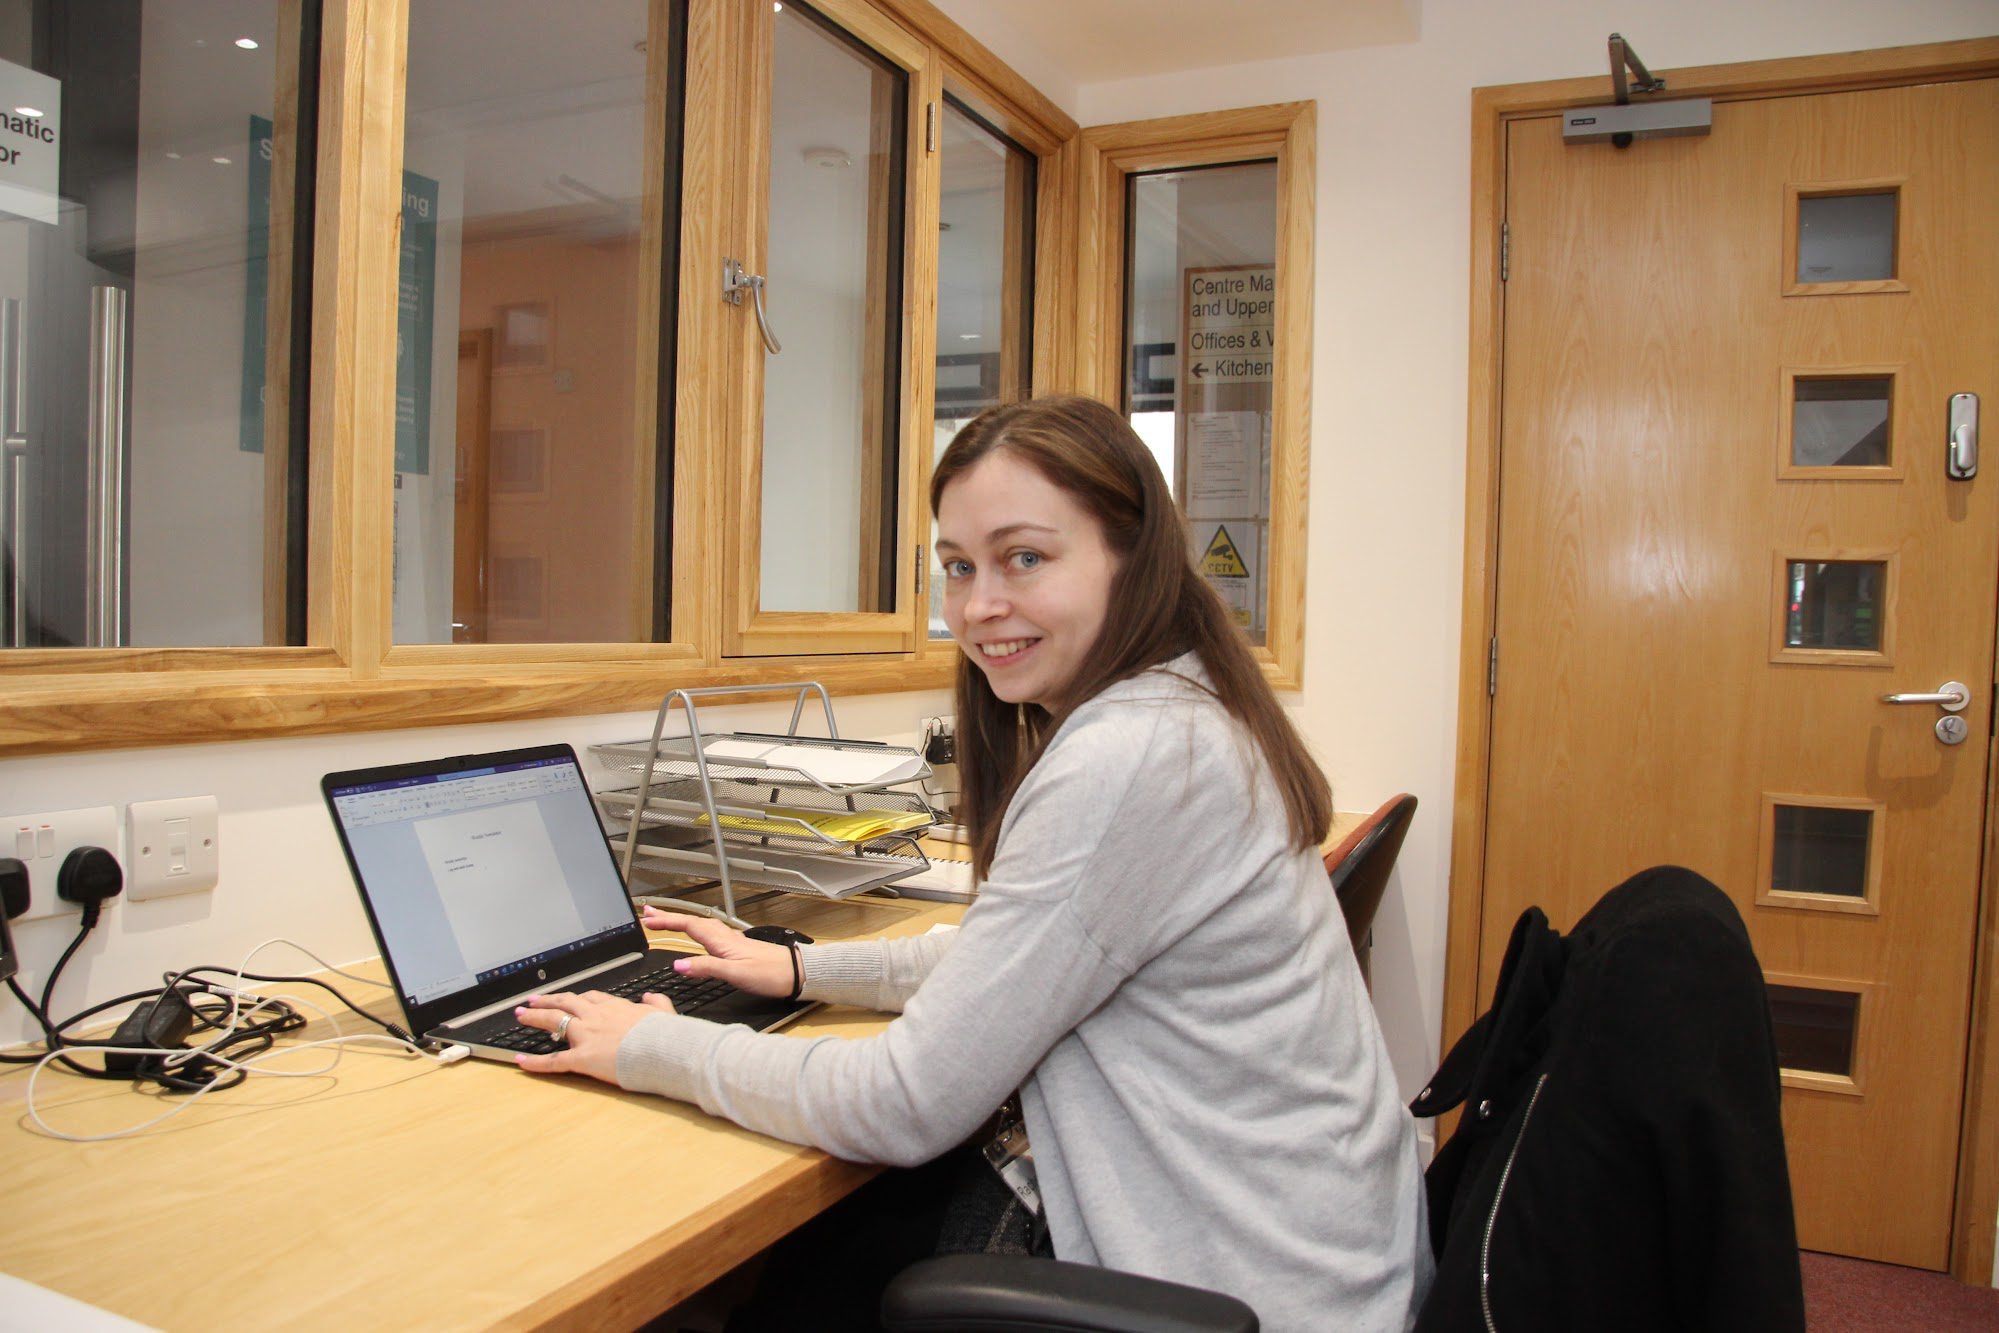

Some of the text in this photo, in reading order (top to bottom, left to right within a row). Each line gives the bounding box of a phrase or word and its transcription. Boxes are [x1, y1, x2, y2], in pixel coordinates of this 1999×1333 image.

[1192, 278, 1244, 296] Centre
[1192, 298, 1274, 319] and Upper
[1191, 332, 1245, 350] Offices
[1250, 330, 1261, 348] &
[1215, 359, 1273, 377] Kitchen
[1207, 563, 1234, 573] CCTV
